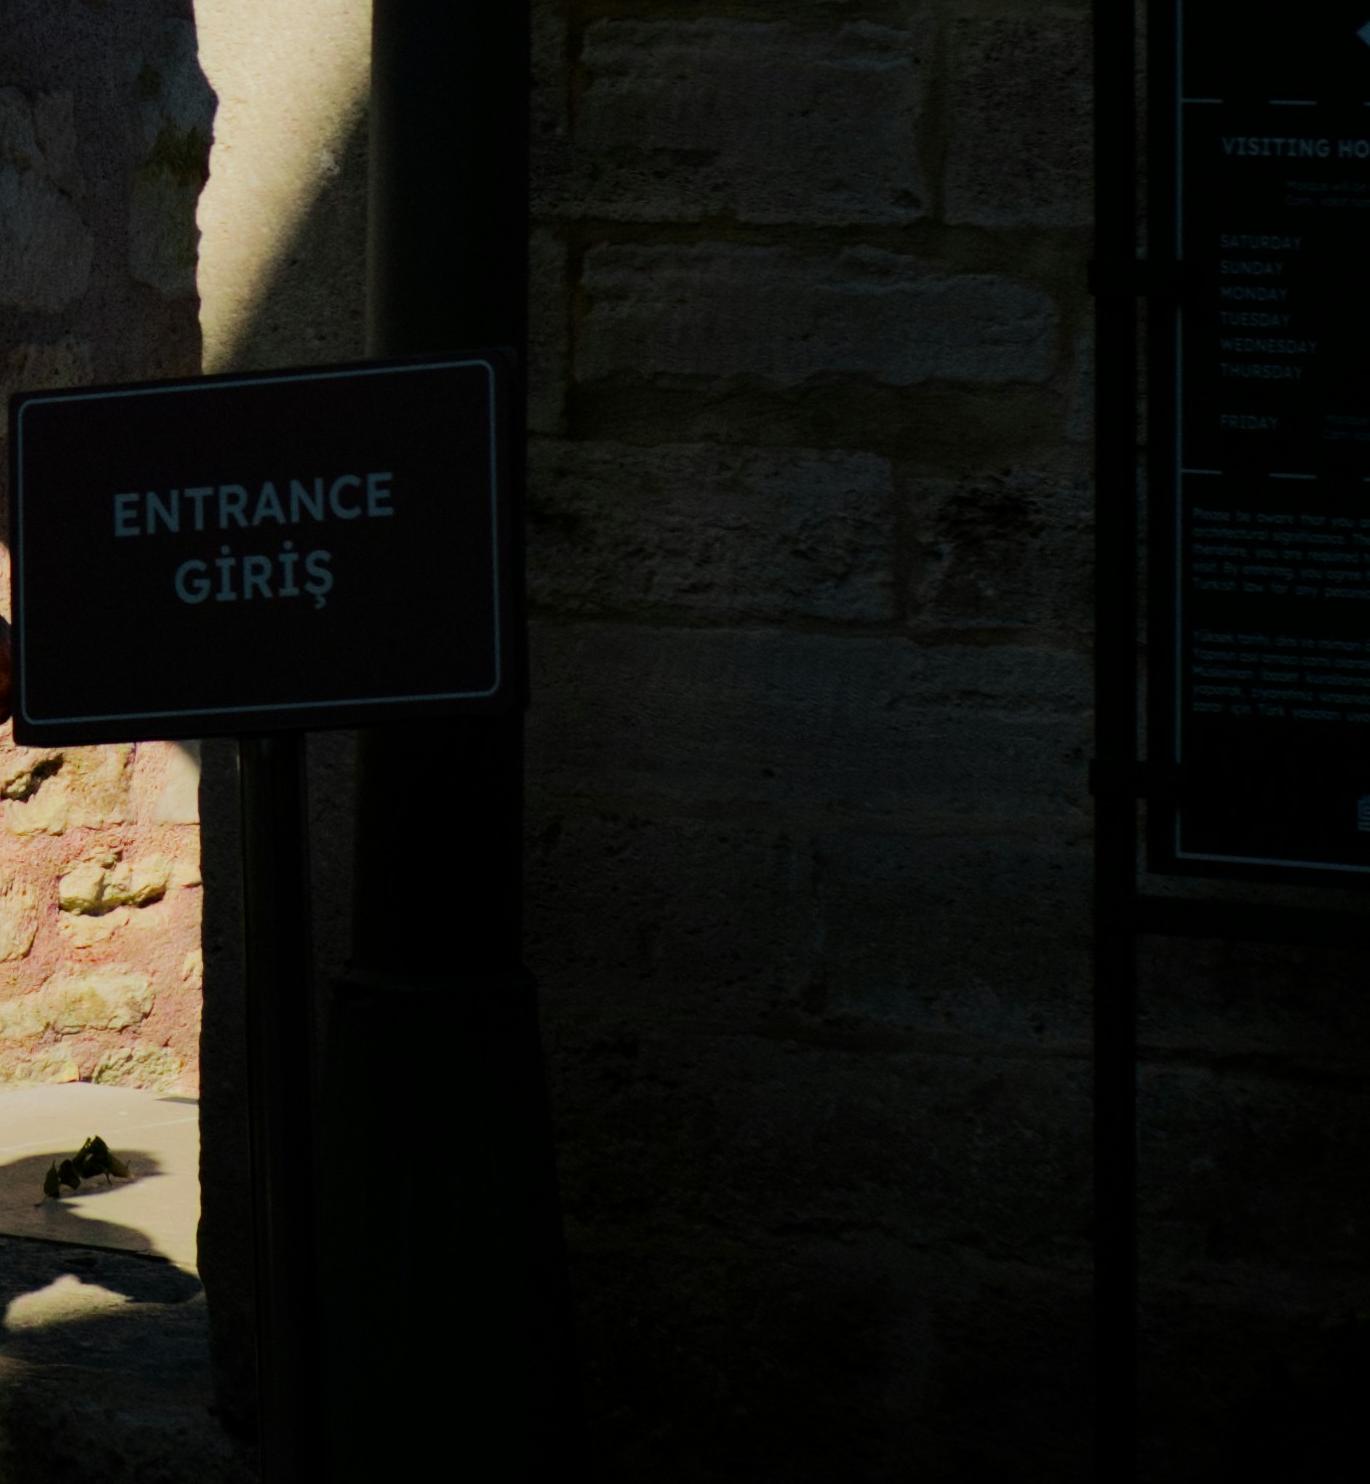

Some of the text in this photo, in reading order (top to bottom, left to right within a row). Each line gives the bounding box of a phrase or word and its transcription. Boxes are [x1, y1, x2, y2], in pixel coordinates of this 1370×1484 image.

[1221, 136, 1331, 158] VISITING
[114, 472, 394, 537] ENTRANCE
[174, 540, 334, 609] GİRİŞ
